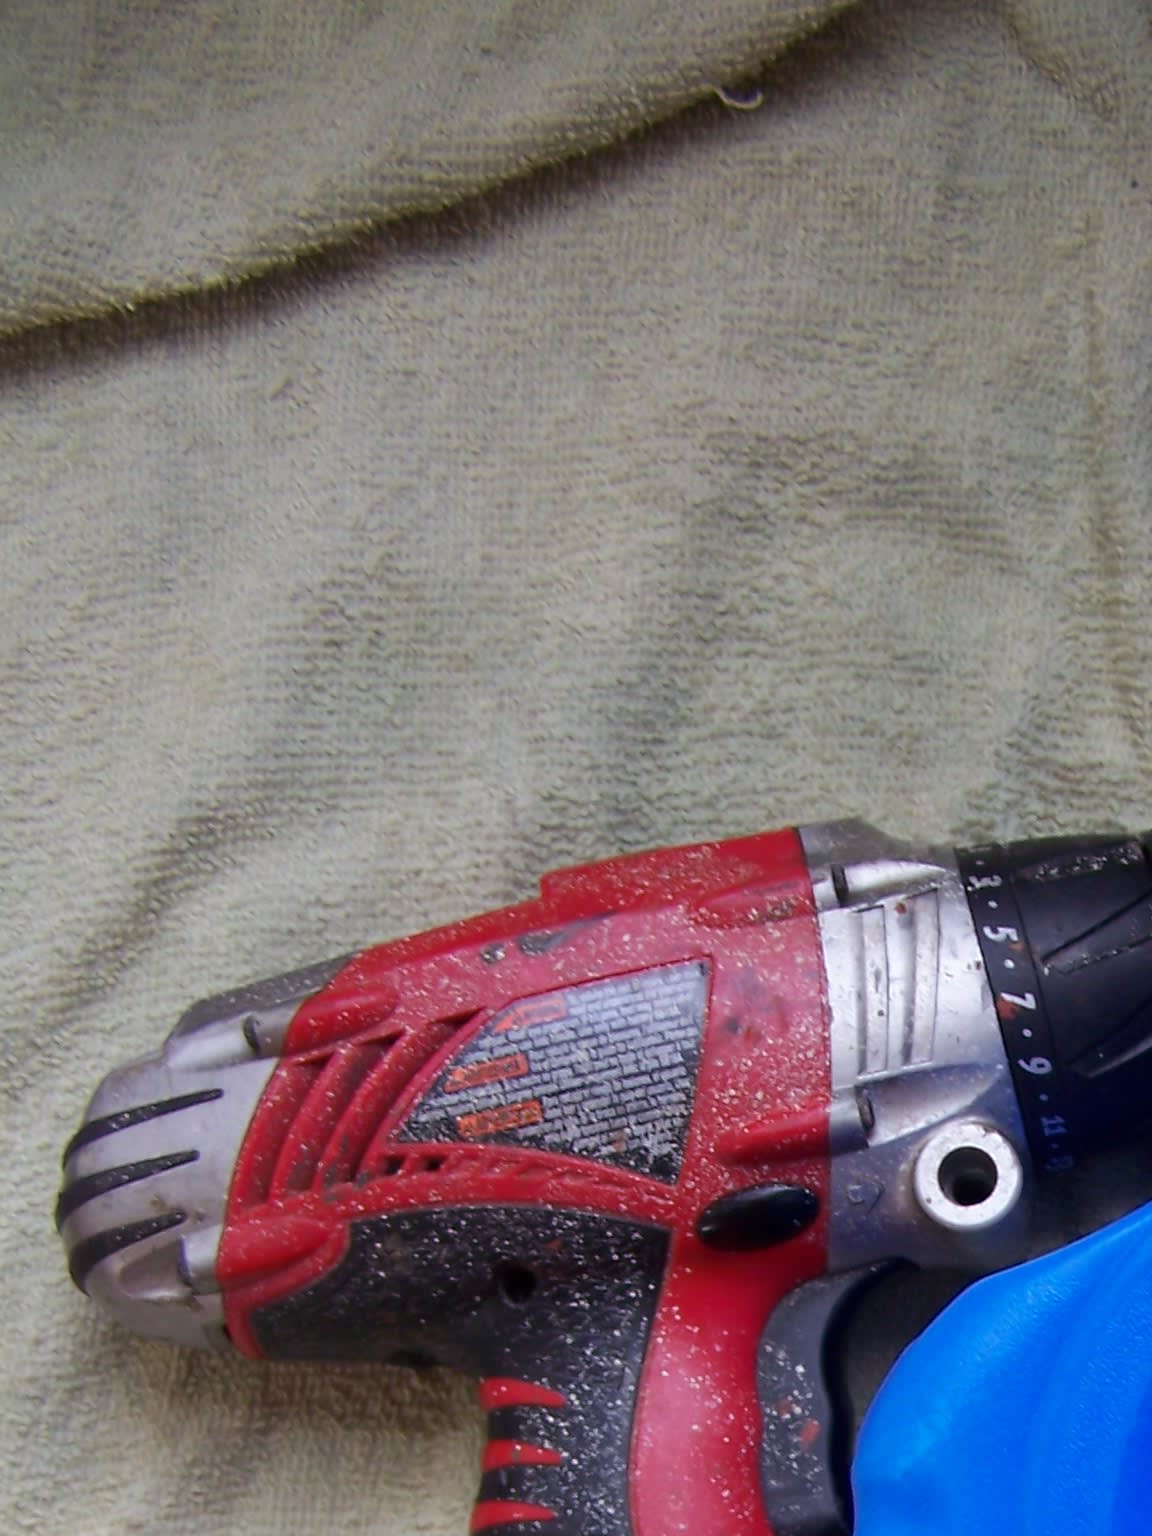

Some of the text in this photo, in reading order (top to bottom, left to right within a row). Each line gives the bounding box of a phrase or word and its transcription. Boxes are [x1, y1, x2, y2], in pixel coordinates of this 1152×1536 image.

[967, 874, 1003, 890] 3
[982, 925, 1020, 943] 5
[999, 991, 1037, 1011] 7
[1016, 1055, 1053, 1075] 9
[1039, 1114, 1069, 1138] 11
